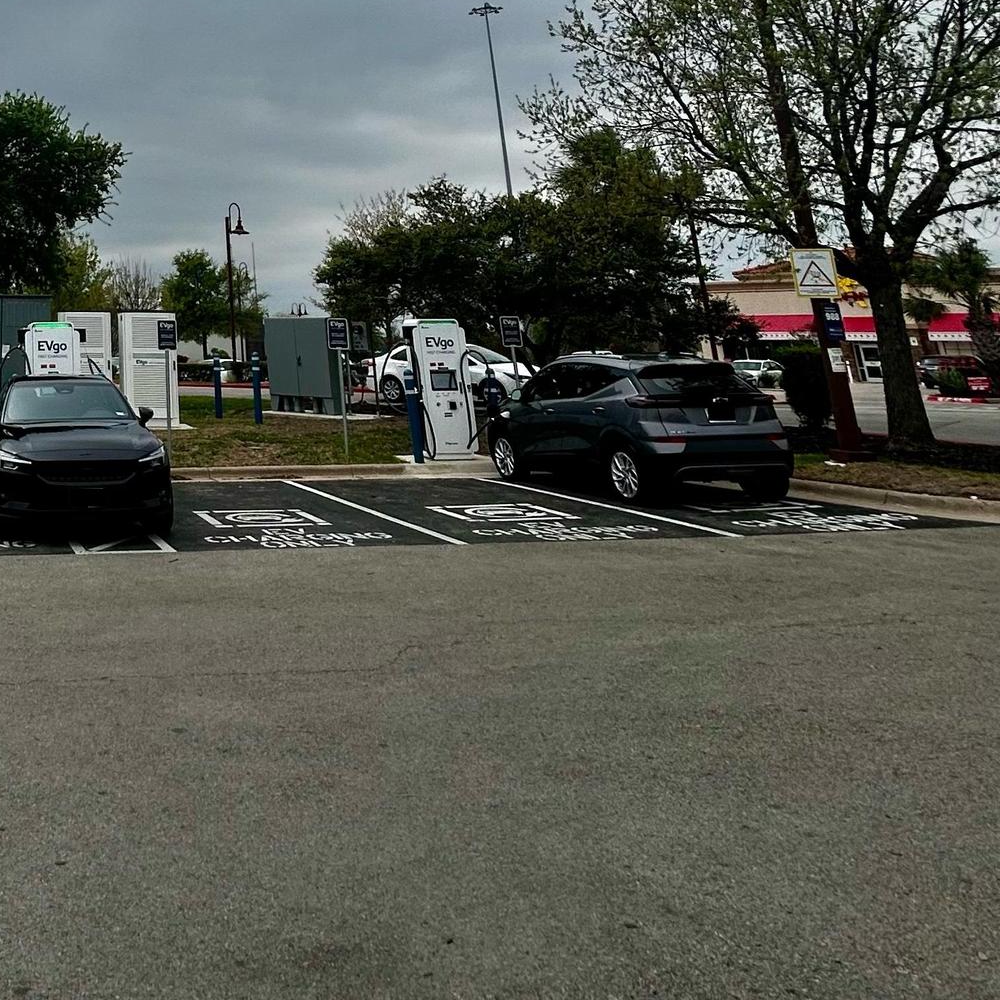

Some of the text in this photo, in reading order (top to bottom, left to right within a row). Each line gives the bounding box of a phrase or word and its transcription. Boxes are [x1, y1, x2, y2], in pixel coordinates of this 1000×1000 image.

[38, 341, 67, 353] EVgo
[425, 337, 454, 349] EVgo
[204, 532, 392, 543] CHARGING
